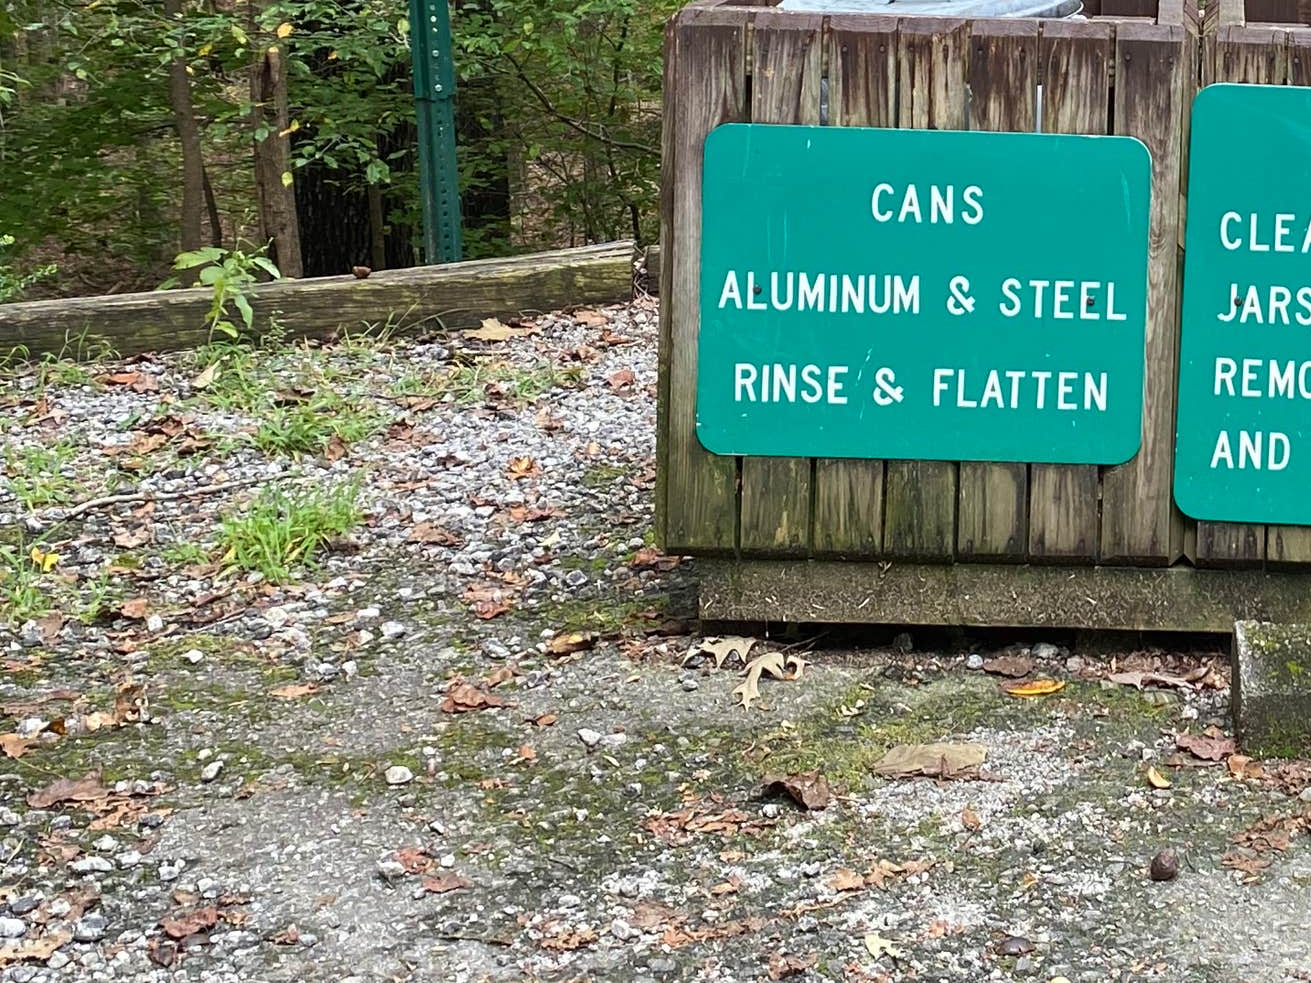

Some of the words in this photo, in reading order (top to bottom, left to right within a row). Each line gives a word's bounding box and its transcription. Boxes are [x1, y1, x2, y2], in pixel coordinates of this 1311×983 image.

[872, 184, 983, 224] CANS
[719, 271, 919, 313] ALUMINUM
[947, 276, 975, 315] &
[1000, 279, 1126, 320] STEEL
[735, 364, 848, 403] RINSE
[874, 368, 903, 405] &
[934, 369, 1107, 410] FLATTEN
[1211, 431, 1290, 470] AND
